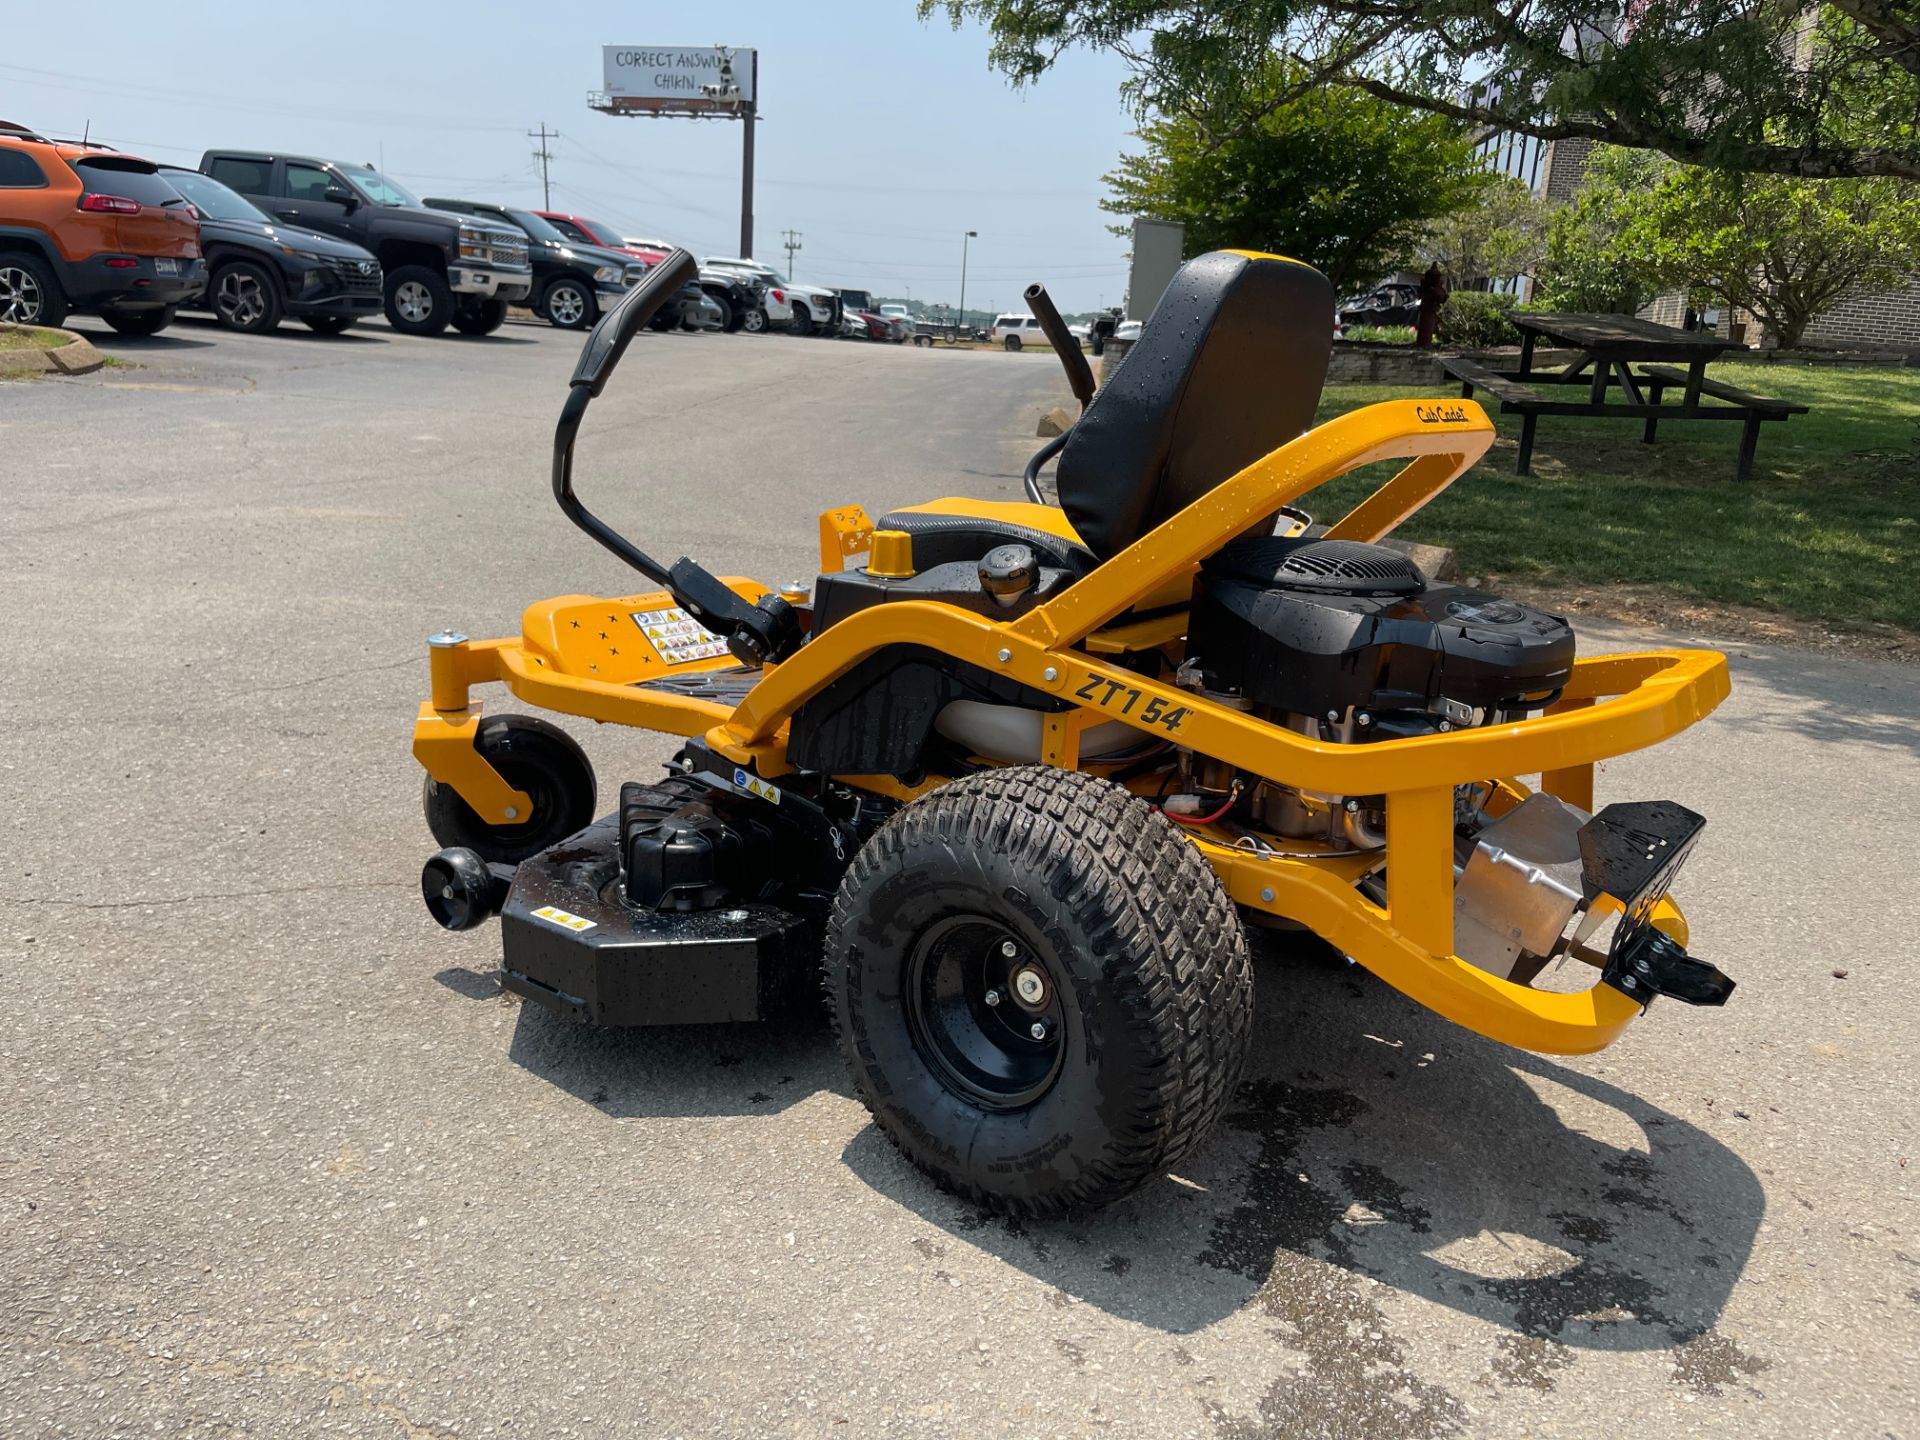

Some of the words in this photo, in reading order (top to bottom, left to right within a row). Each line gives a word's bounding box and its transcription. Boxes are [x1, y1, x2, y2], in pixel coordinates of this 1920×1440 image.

[616, 51, 673, 68] CORRECT
[676, 53, 721, 68] ANSWU
[1416, 406, 1439, 423] Cub
[1436, 405, 1469, 422] Cadet
[1075, 672, 1142, 714] ZT1
